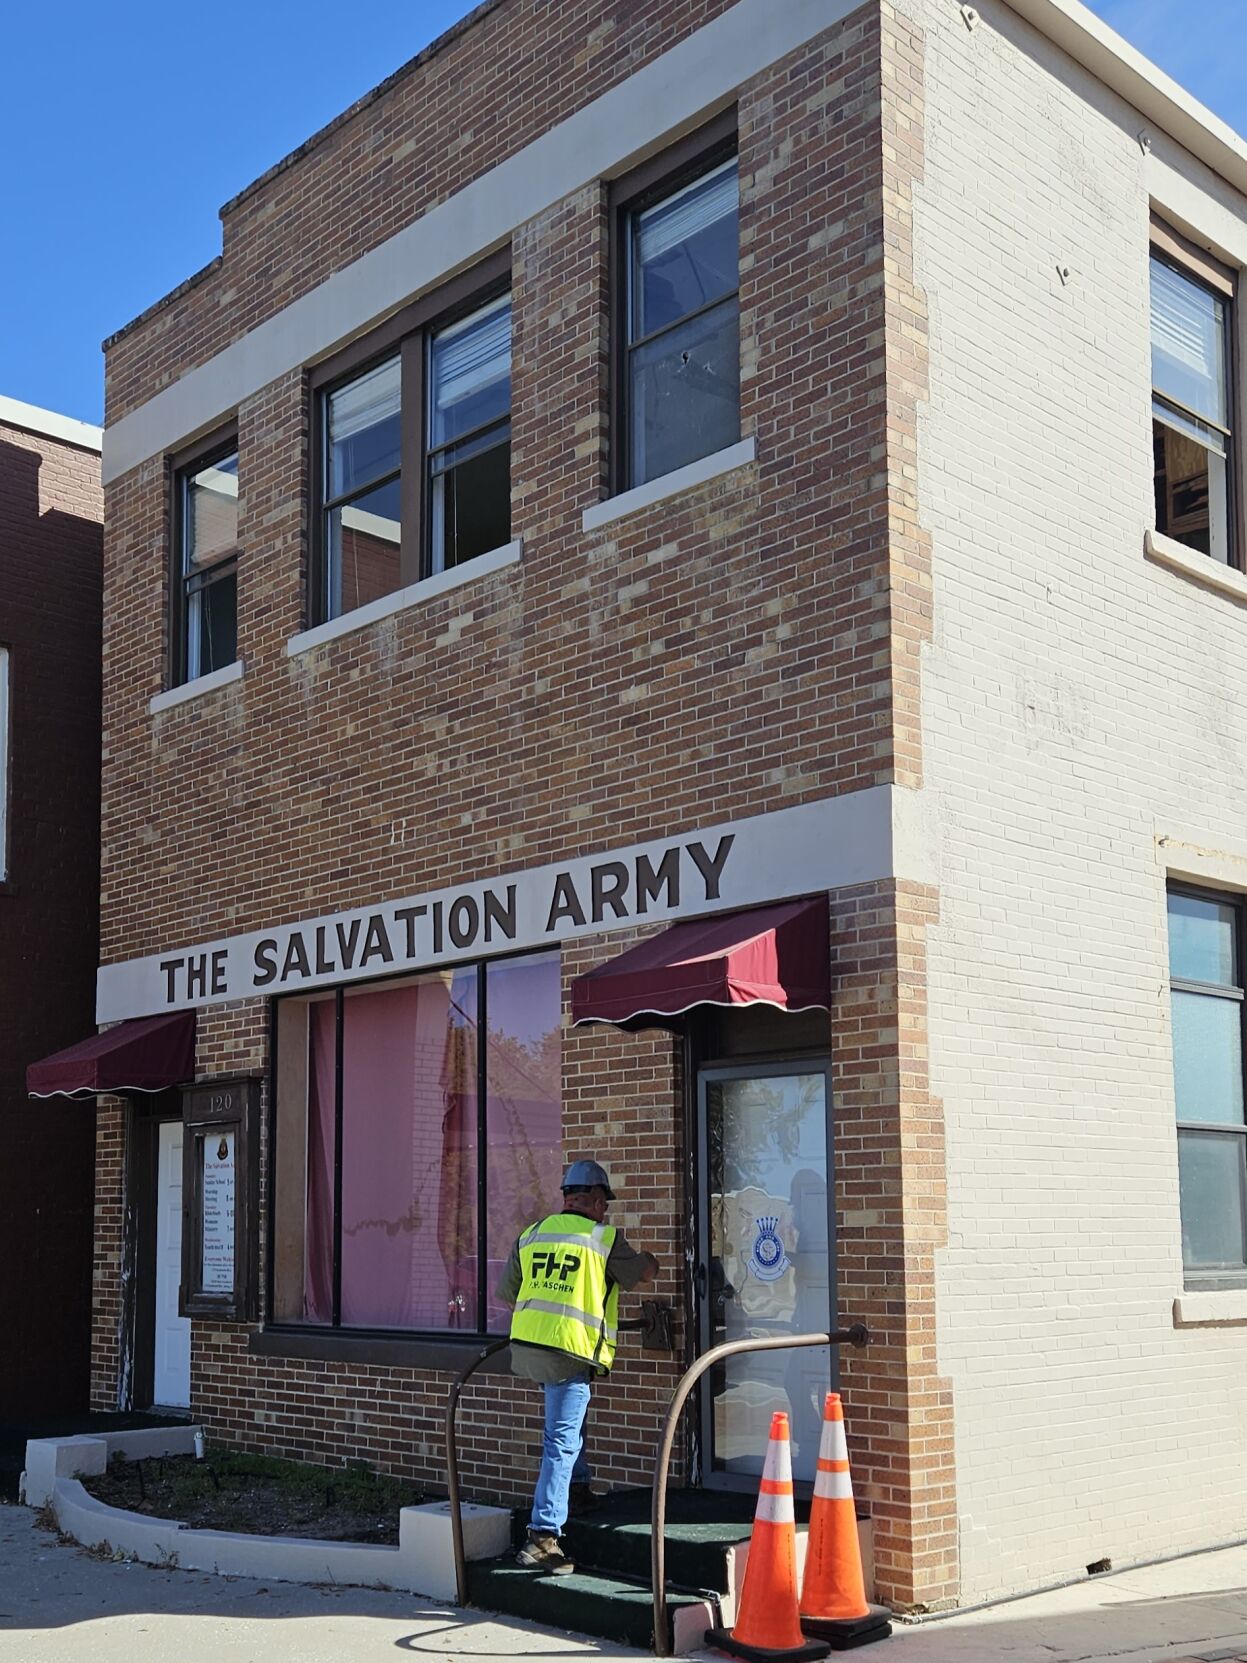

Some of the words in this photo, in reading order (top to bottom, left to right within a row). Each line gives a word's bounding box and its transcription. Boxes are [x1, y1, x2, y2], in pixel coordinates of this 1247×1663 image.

[160, 949, 228, 1003] THE
[253, 884, 517, 987] SALVATION
[545, 834, 736, 932] ARMY
[211, 1093, 232, 1113] 120
[532, 1252, 581, 1281] FHP
[542, 1281, 575, 1294] ASCHEN
